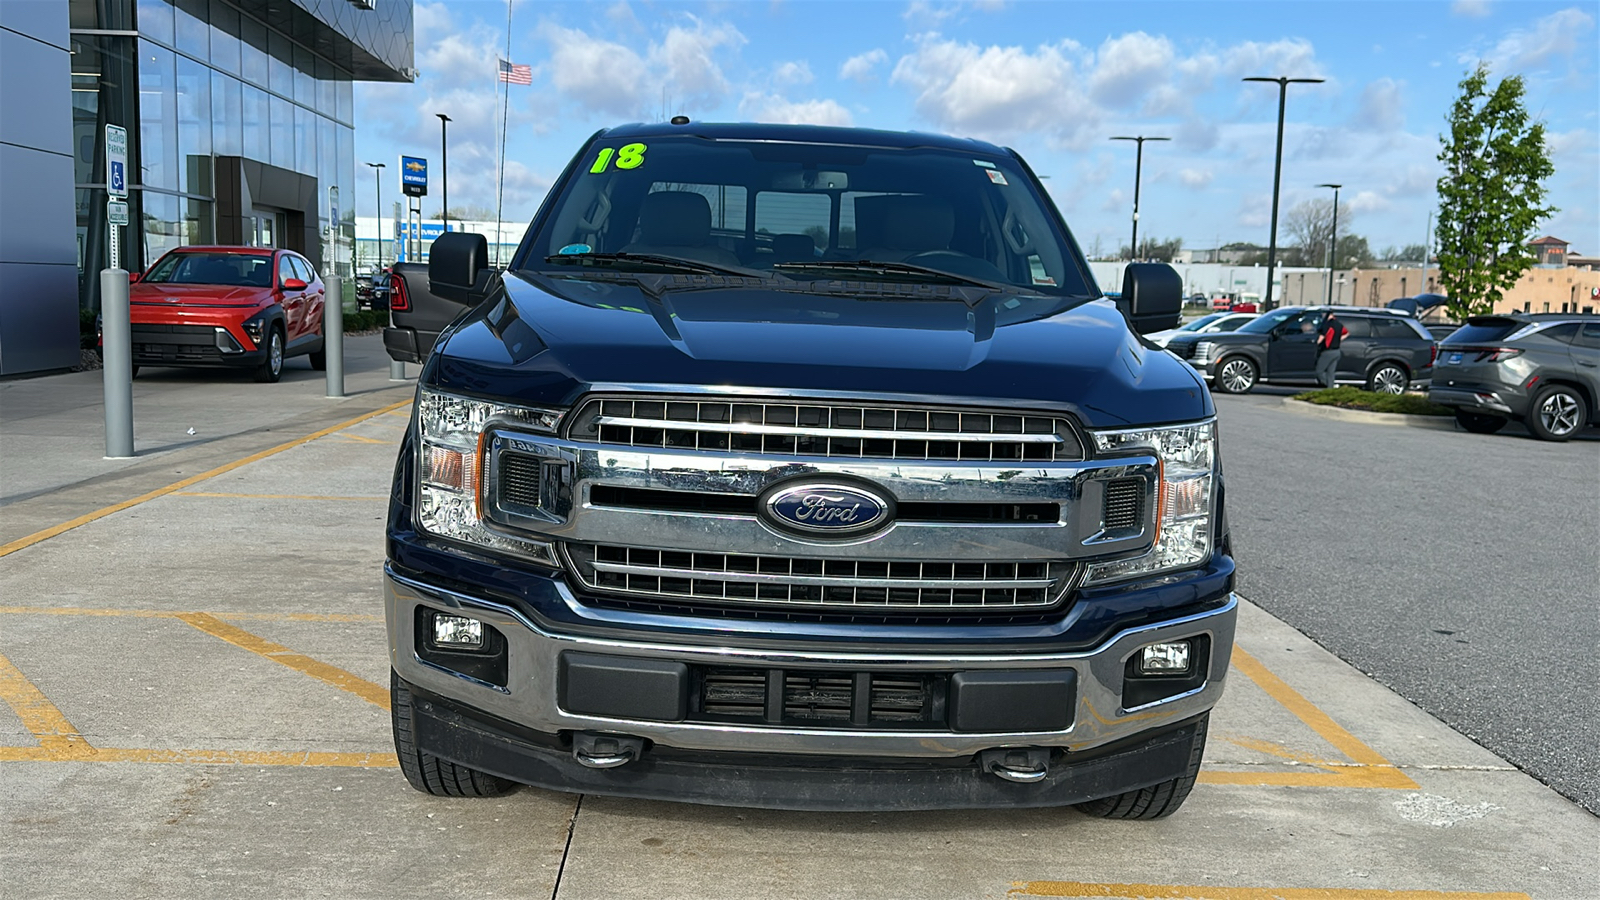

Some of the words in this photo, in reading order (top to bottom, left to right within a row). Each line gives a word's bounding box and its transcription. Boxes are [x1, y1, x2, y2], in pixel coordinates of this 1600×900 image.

[108, 143, 125, 156] PARKING
[589, 142, 648, 174] 18
[795, 494, 861, 522] Ford
